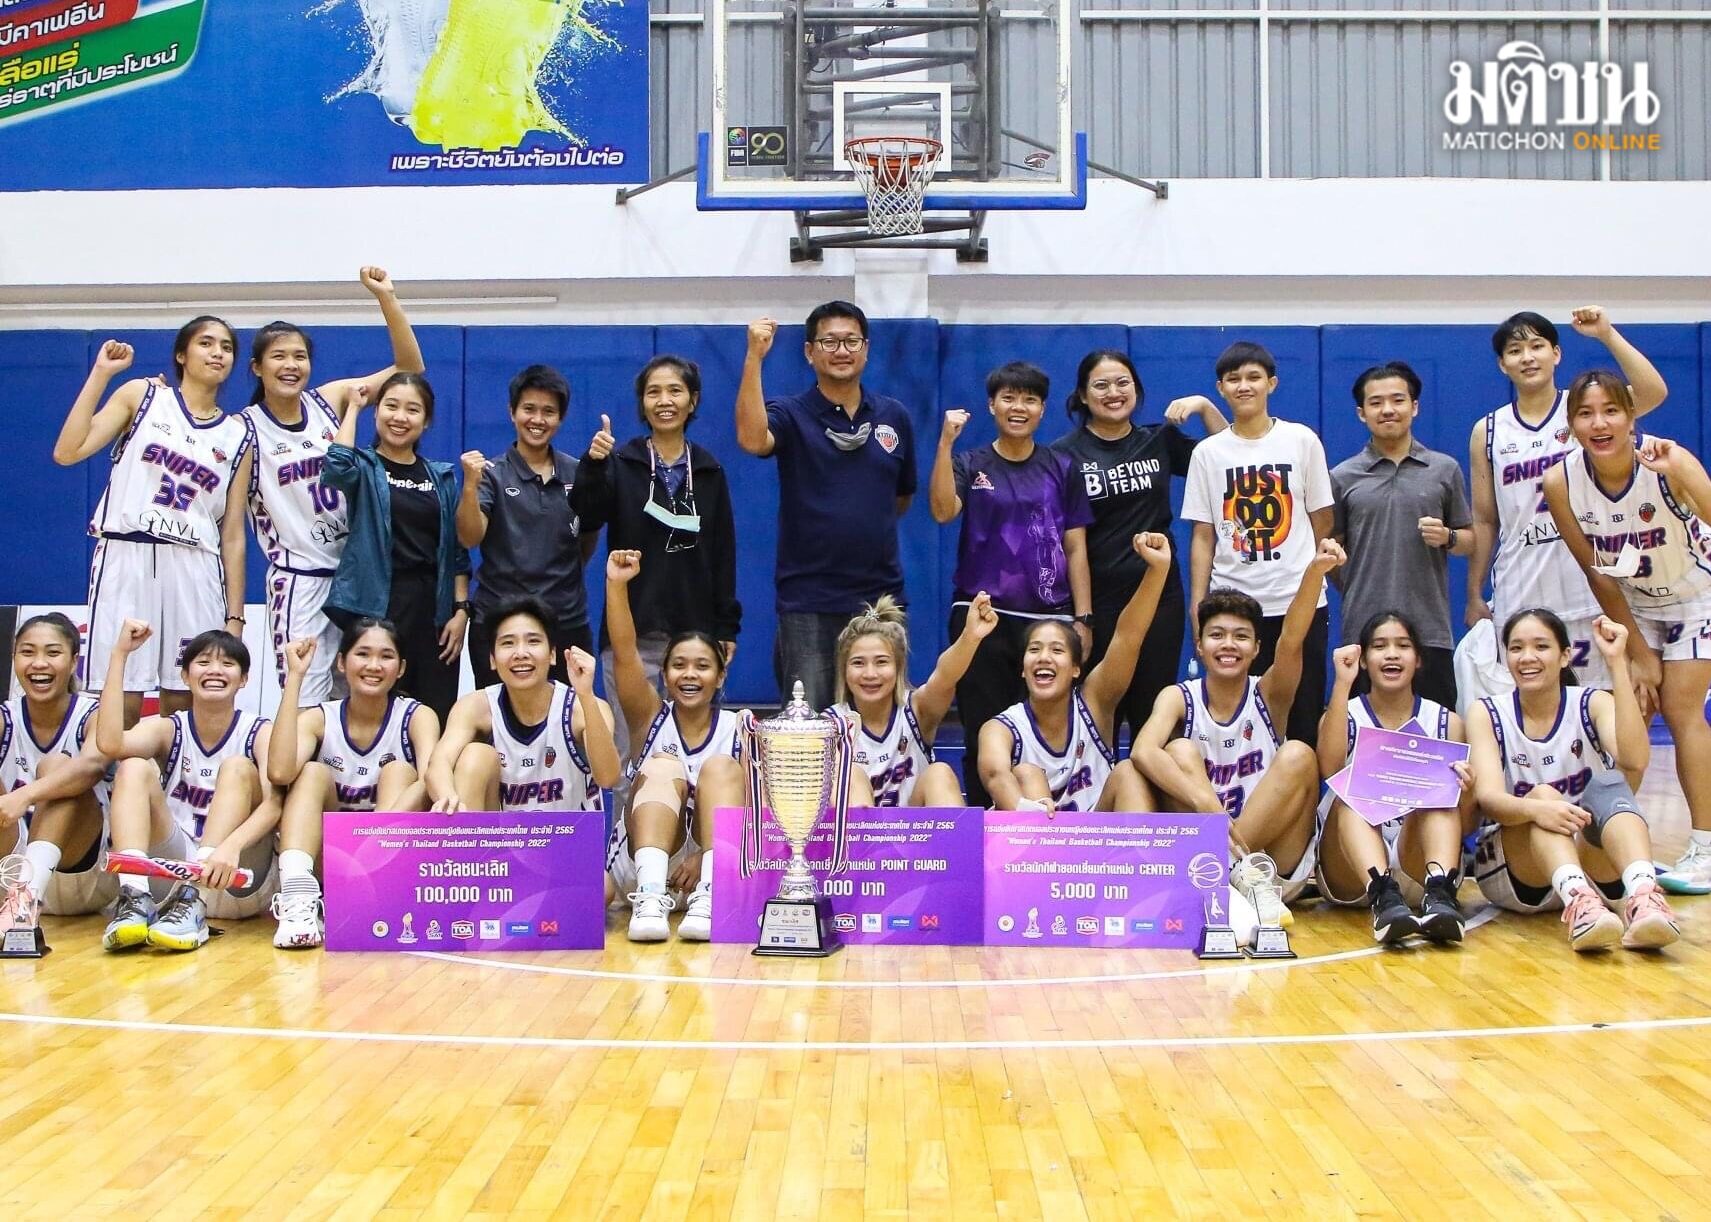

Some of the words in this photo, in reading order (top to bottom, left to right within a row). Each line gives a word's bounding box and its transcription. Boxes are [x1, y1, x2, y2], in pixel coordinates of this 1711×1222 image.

[391, 146, 624, 170] เพราะชีวิตยังต้องไปต่อ
[141, 442, 221, 494] SNIPER
[277, 455, 327, 488] SNIP
[1107, 458, 1161, 480] BEYOND
[1110, 474, 1152, 495] TEAM
[1223, 463, 1293, 501] JUST
[152, 473, 198, 513] 35
[308, 482, 342, 516] 10
[1246, 528, 1281, 562] IT.
[498, 777, 564, 806] NIPER
[555, 826, 575, 835] 2565
[936, 821, 956, 830] 2565
[1180, 826, 1199, 836] 2565
[412, 839, 439, 848] Thailand
[442, 839, 478, 848] Basketball
[480, 839, 525, 848] Championship
[863, 833, 907, 844] Championship
[1068, 837, 1103, 847] Basketball
[419, 858, 509, 877] รางวัลชนะเลิศ
[880, 859, 909, 871] POINT
[914, 859, 947, 871] GUARD
[1139, 863, 1176, 876] CENTER
[415, 885, 480, 904] 100,000
[488, 887, 513, 903] บาท
[818, 879, 853, 898] ,000
[861, 881, 886, 896] บาท
[1050, 881, 1096, 900] 5,000
[1103, 883, 1129, 900] บาท
[453, 926, 474, 935] TOA
[835, 919, 855, 928] TOA
[1077, 921, 1098, 930] TOA
